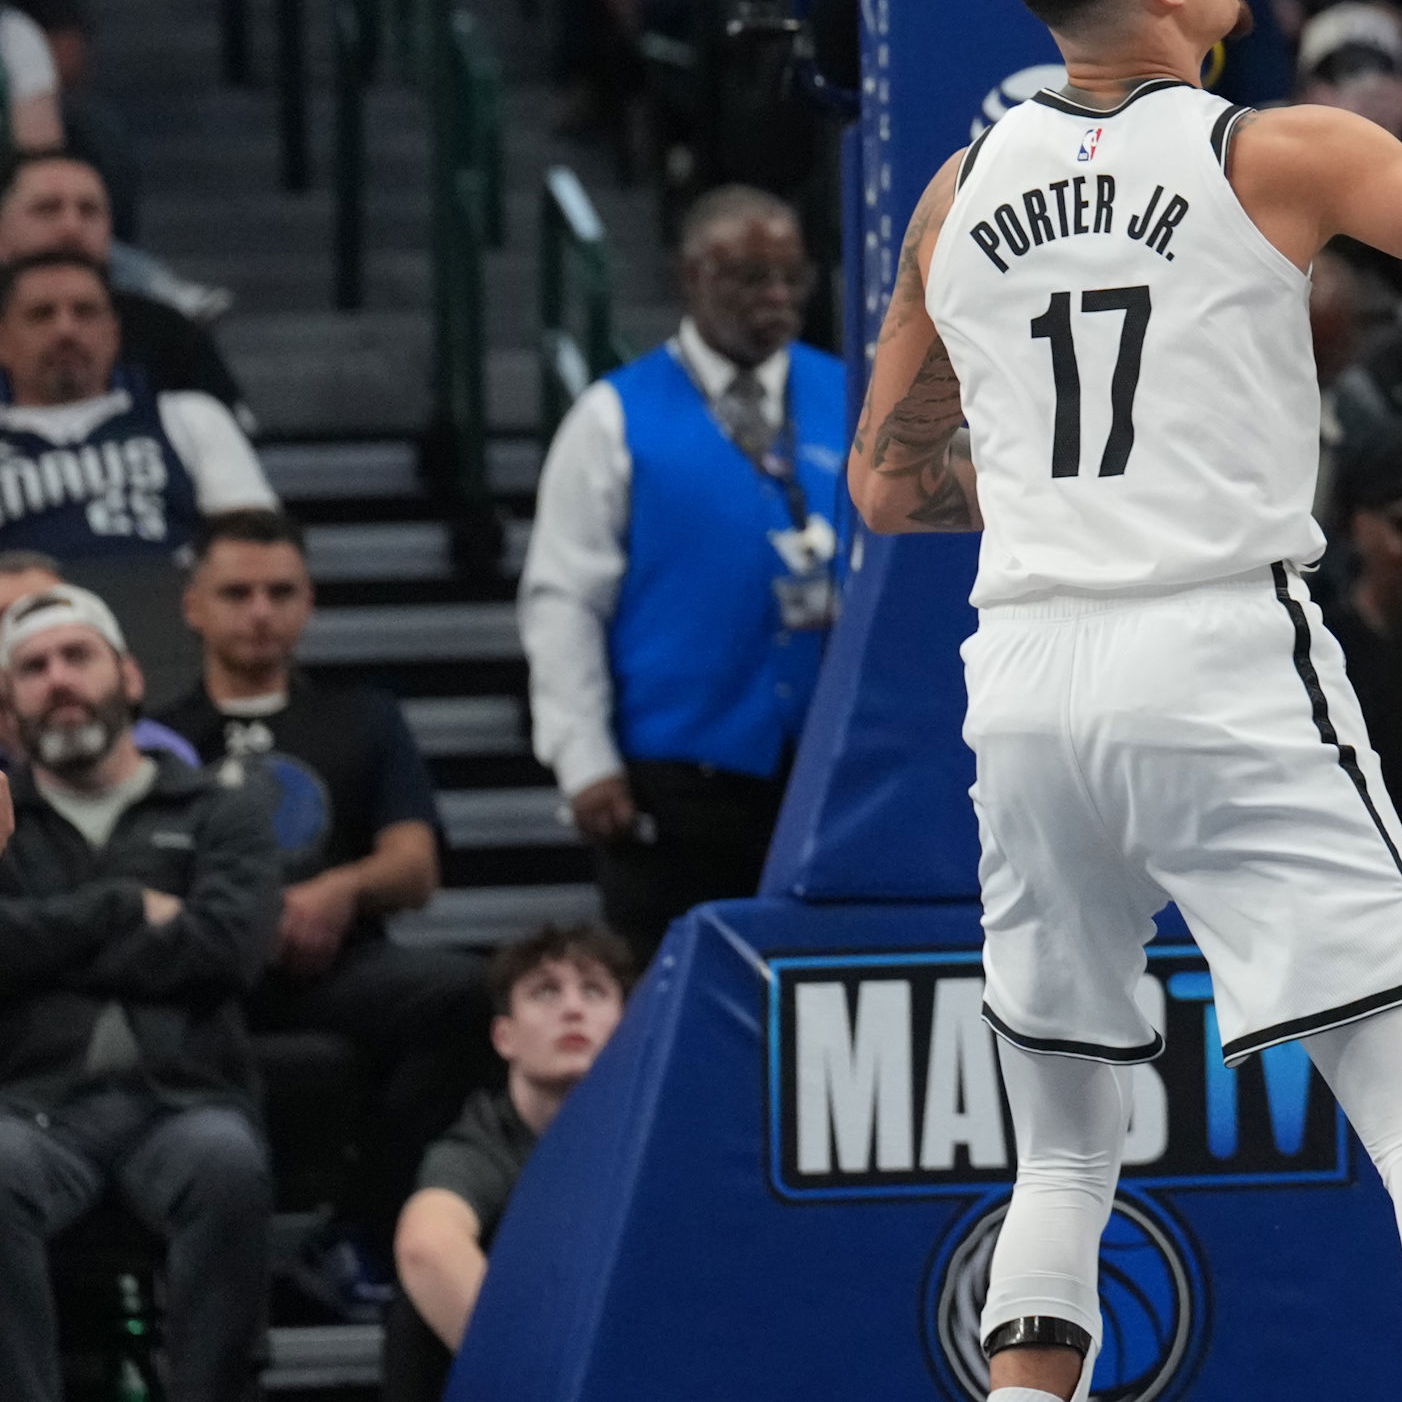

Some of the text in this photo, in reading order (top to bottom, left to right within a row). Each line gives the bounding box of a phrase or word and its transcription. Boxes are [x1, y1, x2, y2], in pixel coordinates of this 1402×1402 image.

[970, 175, 1189, 274] PORTER JR.
[1030, 285, 1152, 478] 17
[795, 973, 1168, 1175] MA
